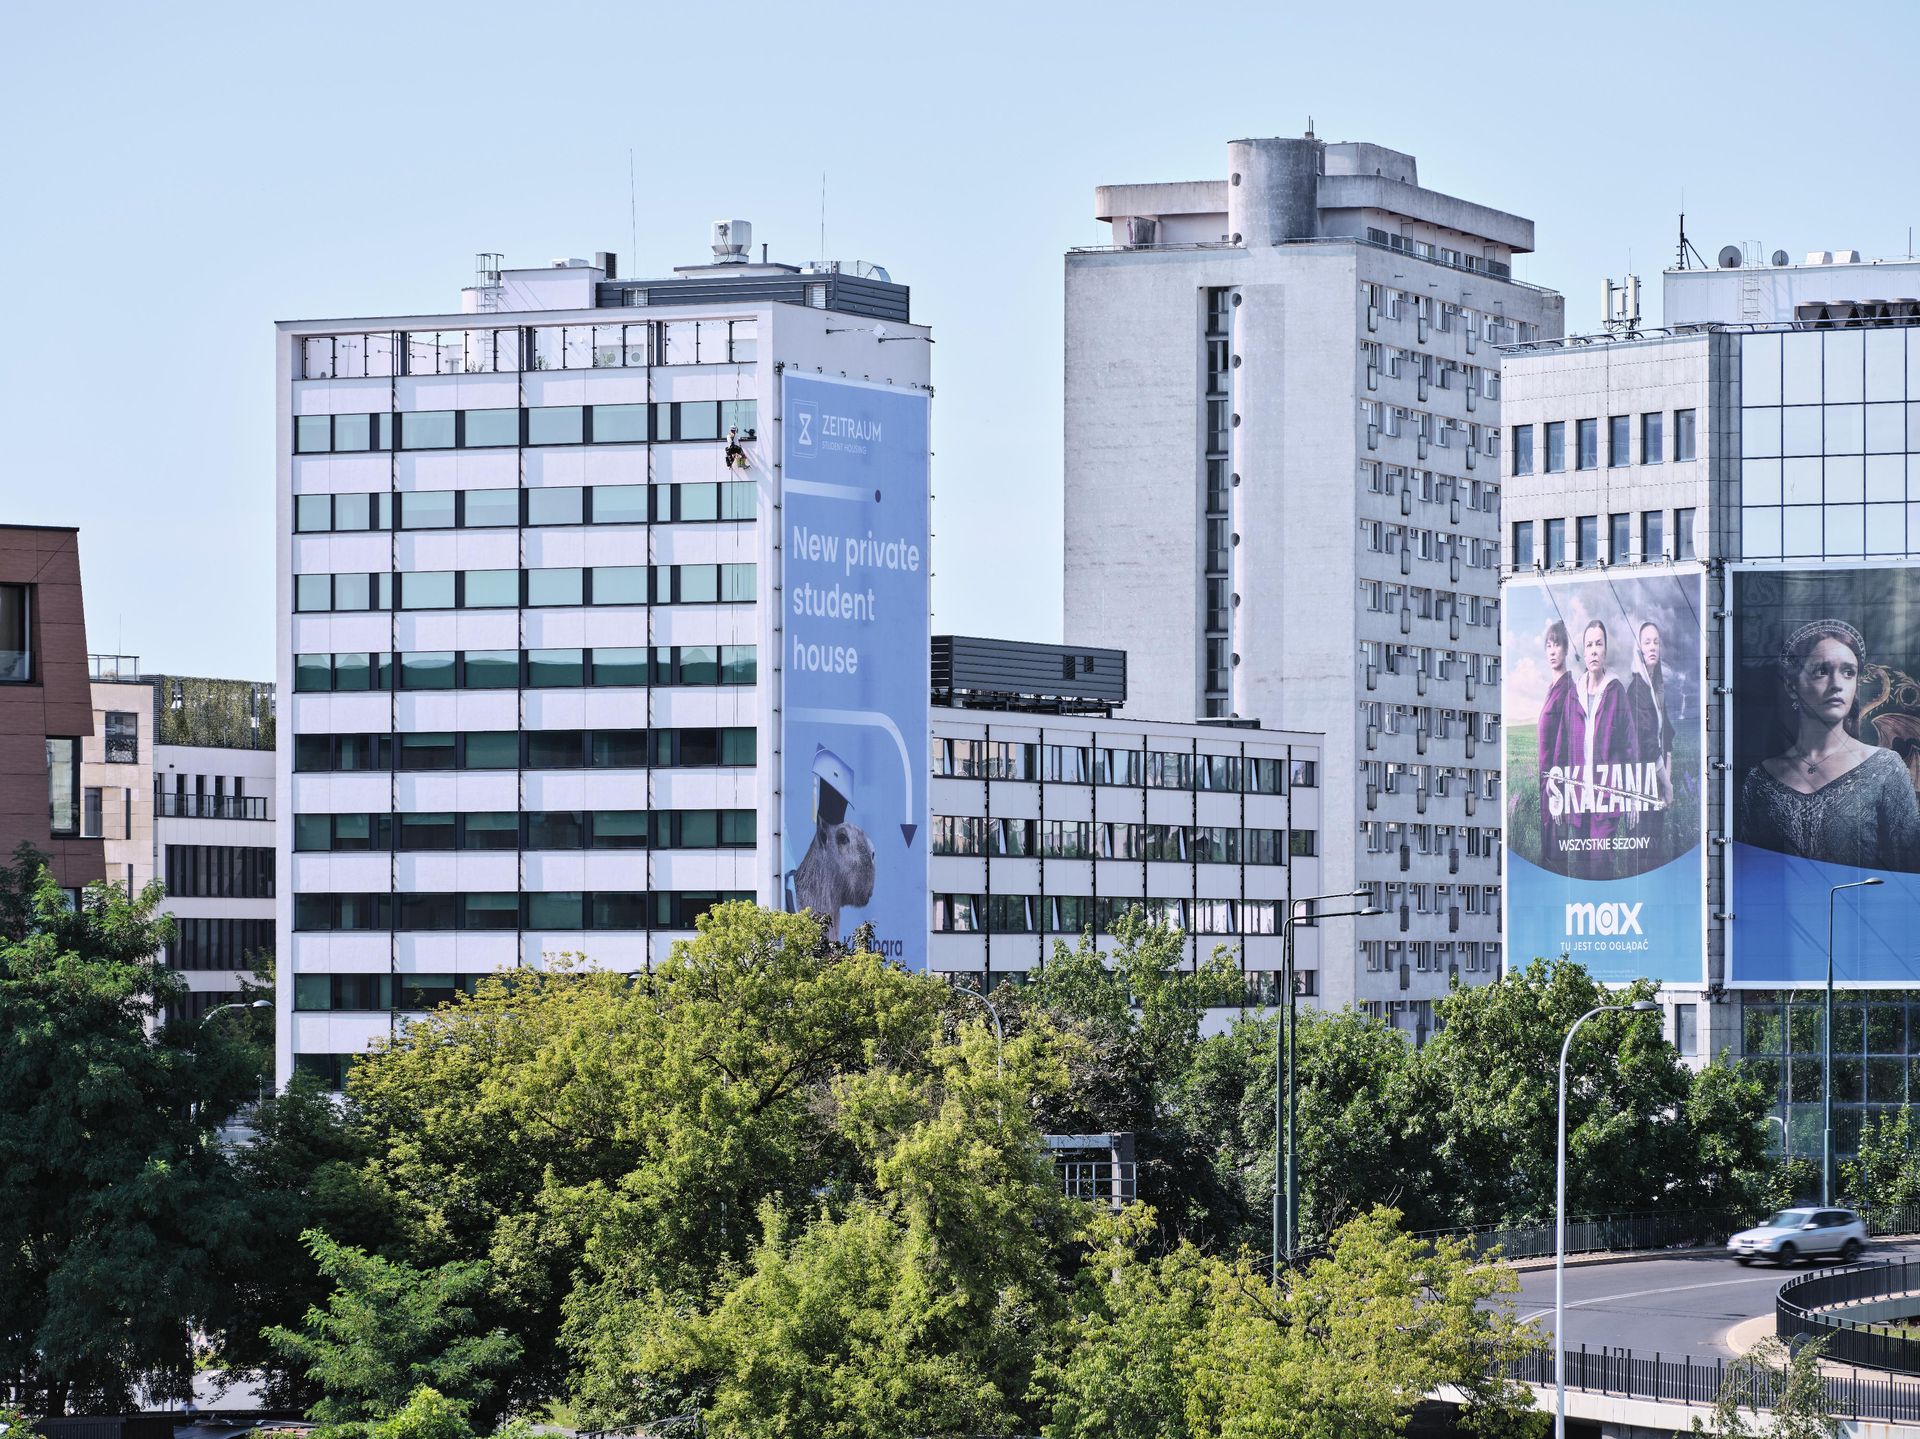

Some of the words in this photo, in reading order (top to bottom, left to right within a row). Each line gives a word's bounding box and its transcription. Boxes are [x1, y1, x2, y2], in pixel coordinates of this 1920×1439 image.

[822, 415, 882, 442] ZEITRAUM
[793, 525, 839, 563] New
[846, 530, 920, 577] private
[793, 582, 875, 621] student
[793, 634, 858, 674] house
[1547, 762, 1662, 815] SKAZANA
[1559, 838, 1611, 851] WSZYSTKIE
[1612, 836, 1651, 850] SEZONY
[1565, 902, 1643, 936] max
[1560, 942, 1571, 951] TU
[1573, 941, 1593, 951] JEST
[1594, 941, 1607, 951] CO
[1609, 938, 1649, 953] OGLĄDAĆ
